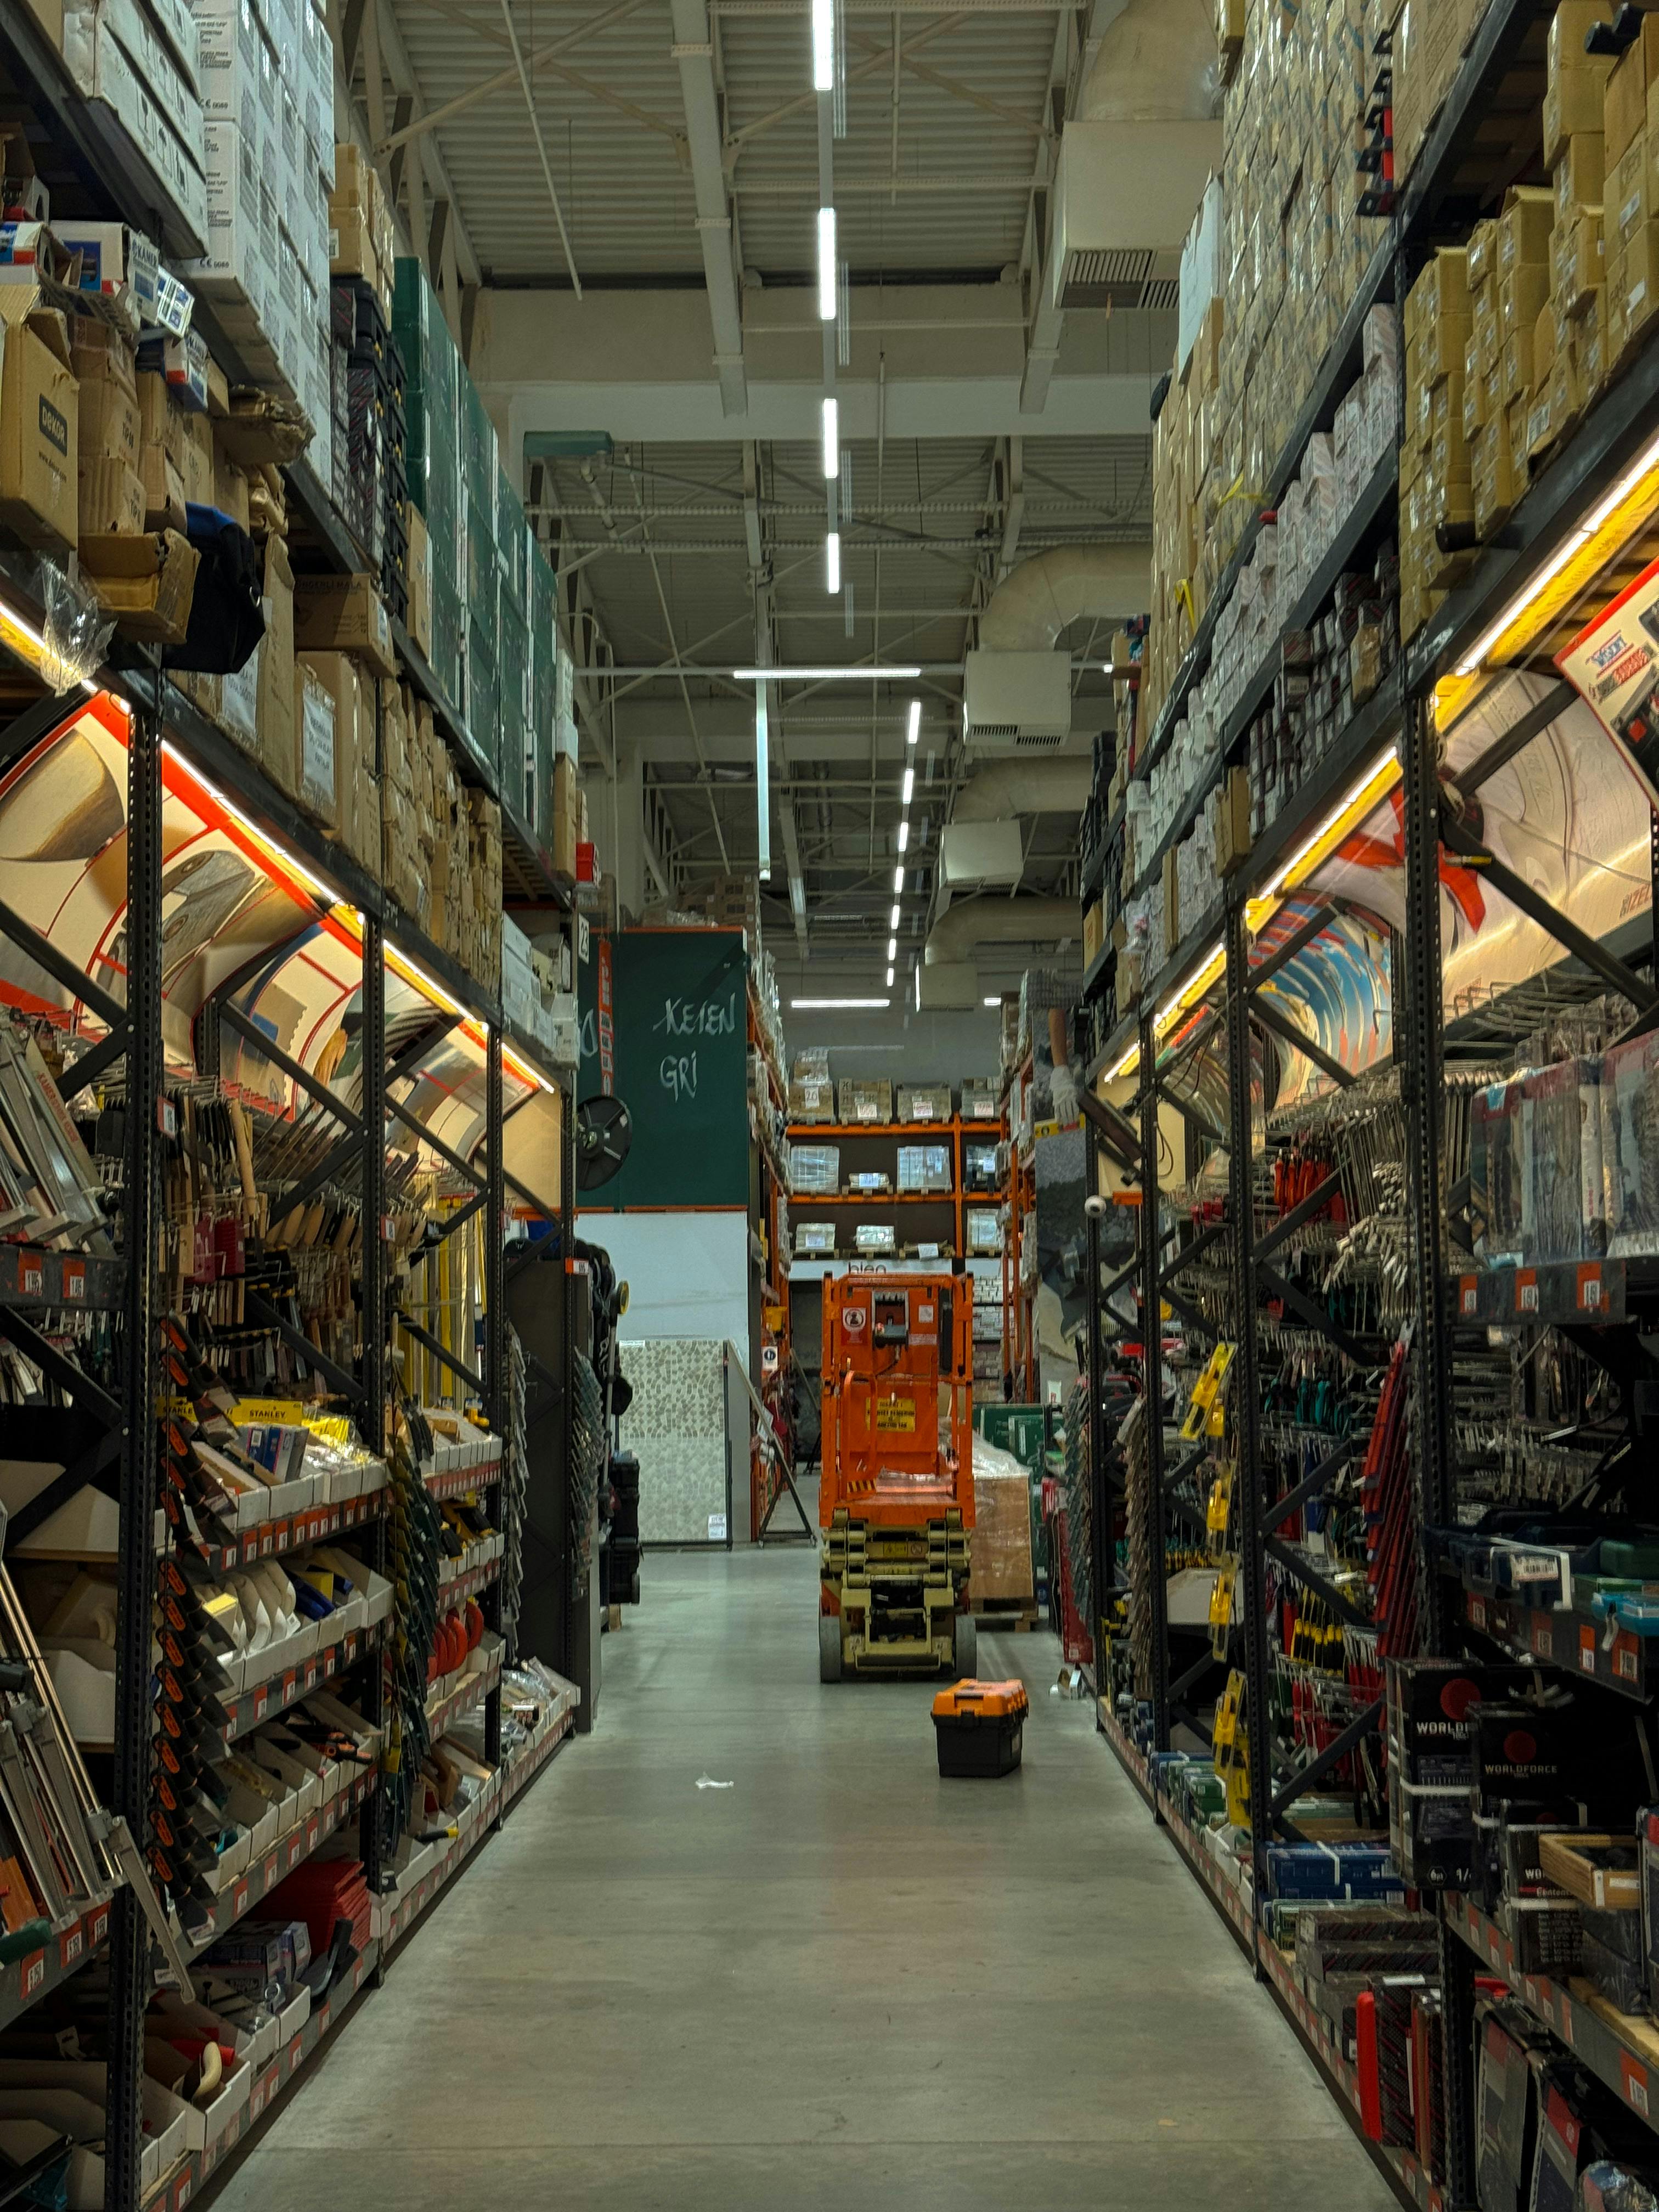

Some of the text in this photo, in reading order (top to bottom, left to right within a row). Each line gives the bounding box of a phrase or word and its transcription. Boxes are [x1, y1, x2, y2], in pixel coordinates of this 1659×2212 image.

[580, 921, 589, 958] 23
[250, 1410, 286, 1418] STANLEY
[1485, 1764, 1558, 1774] WORLDFORCE
